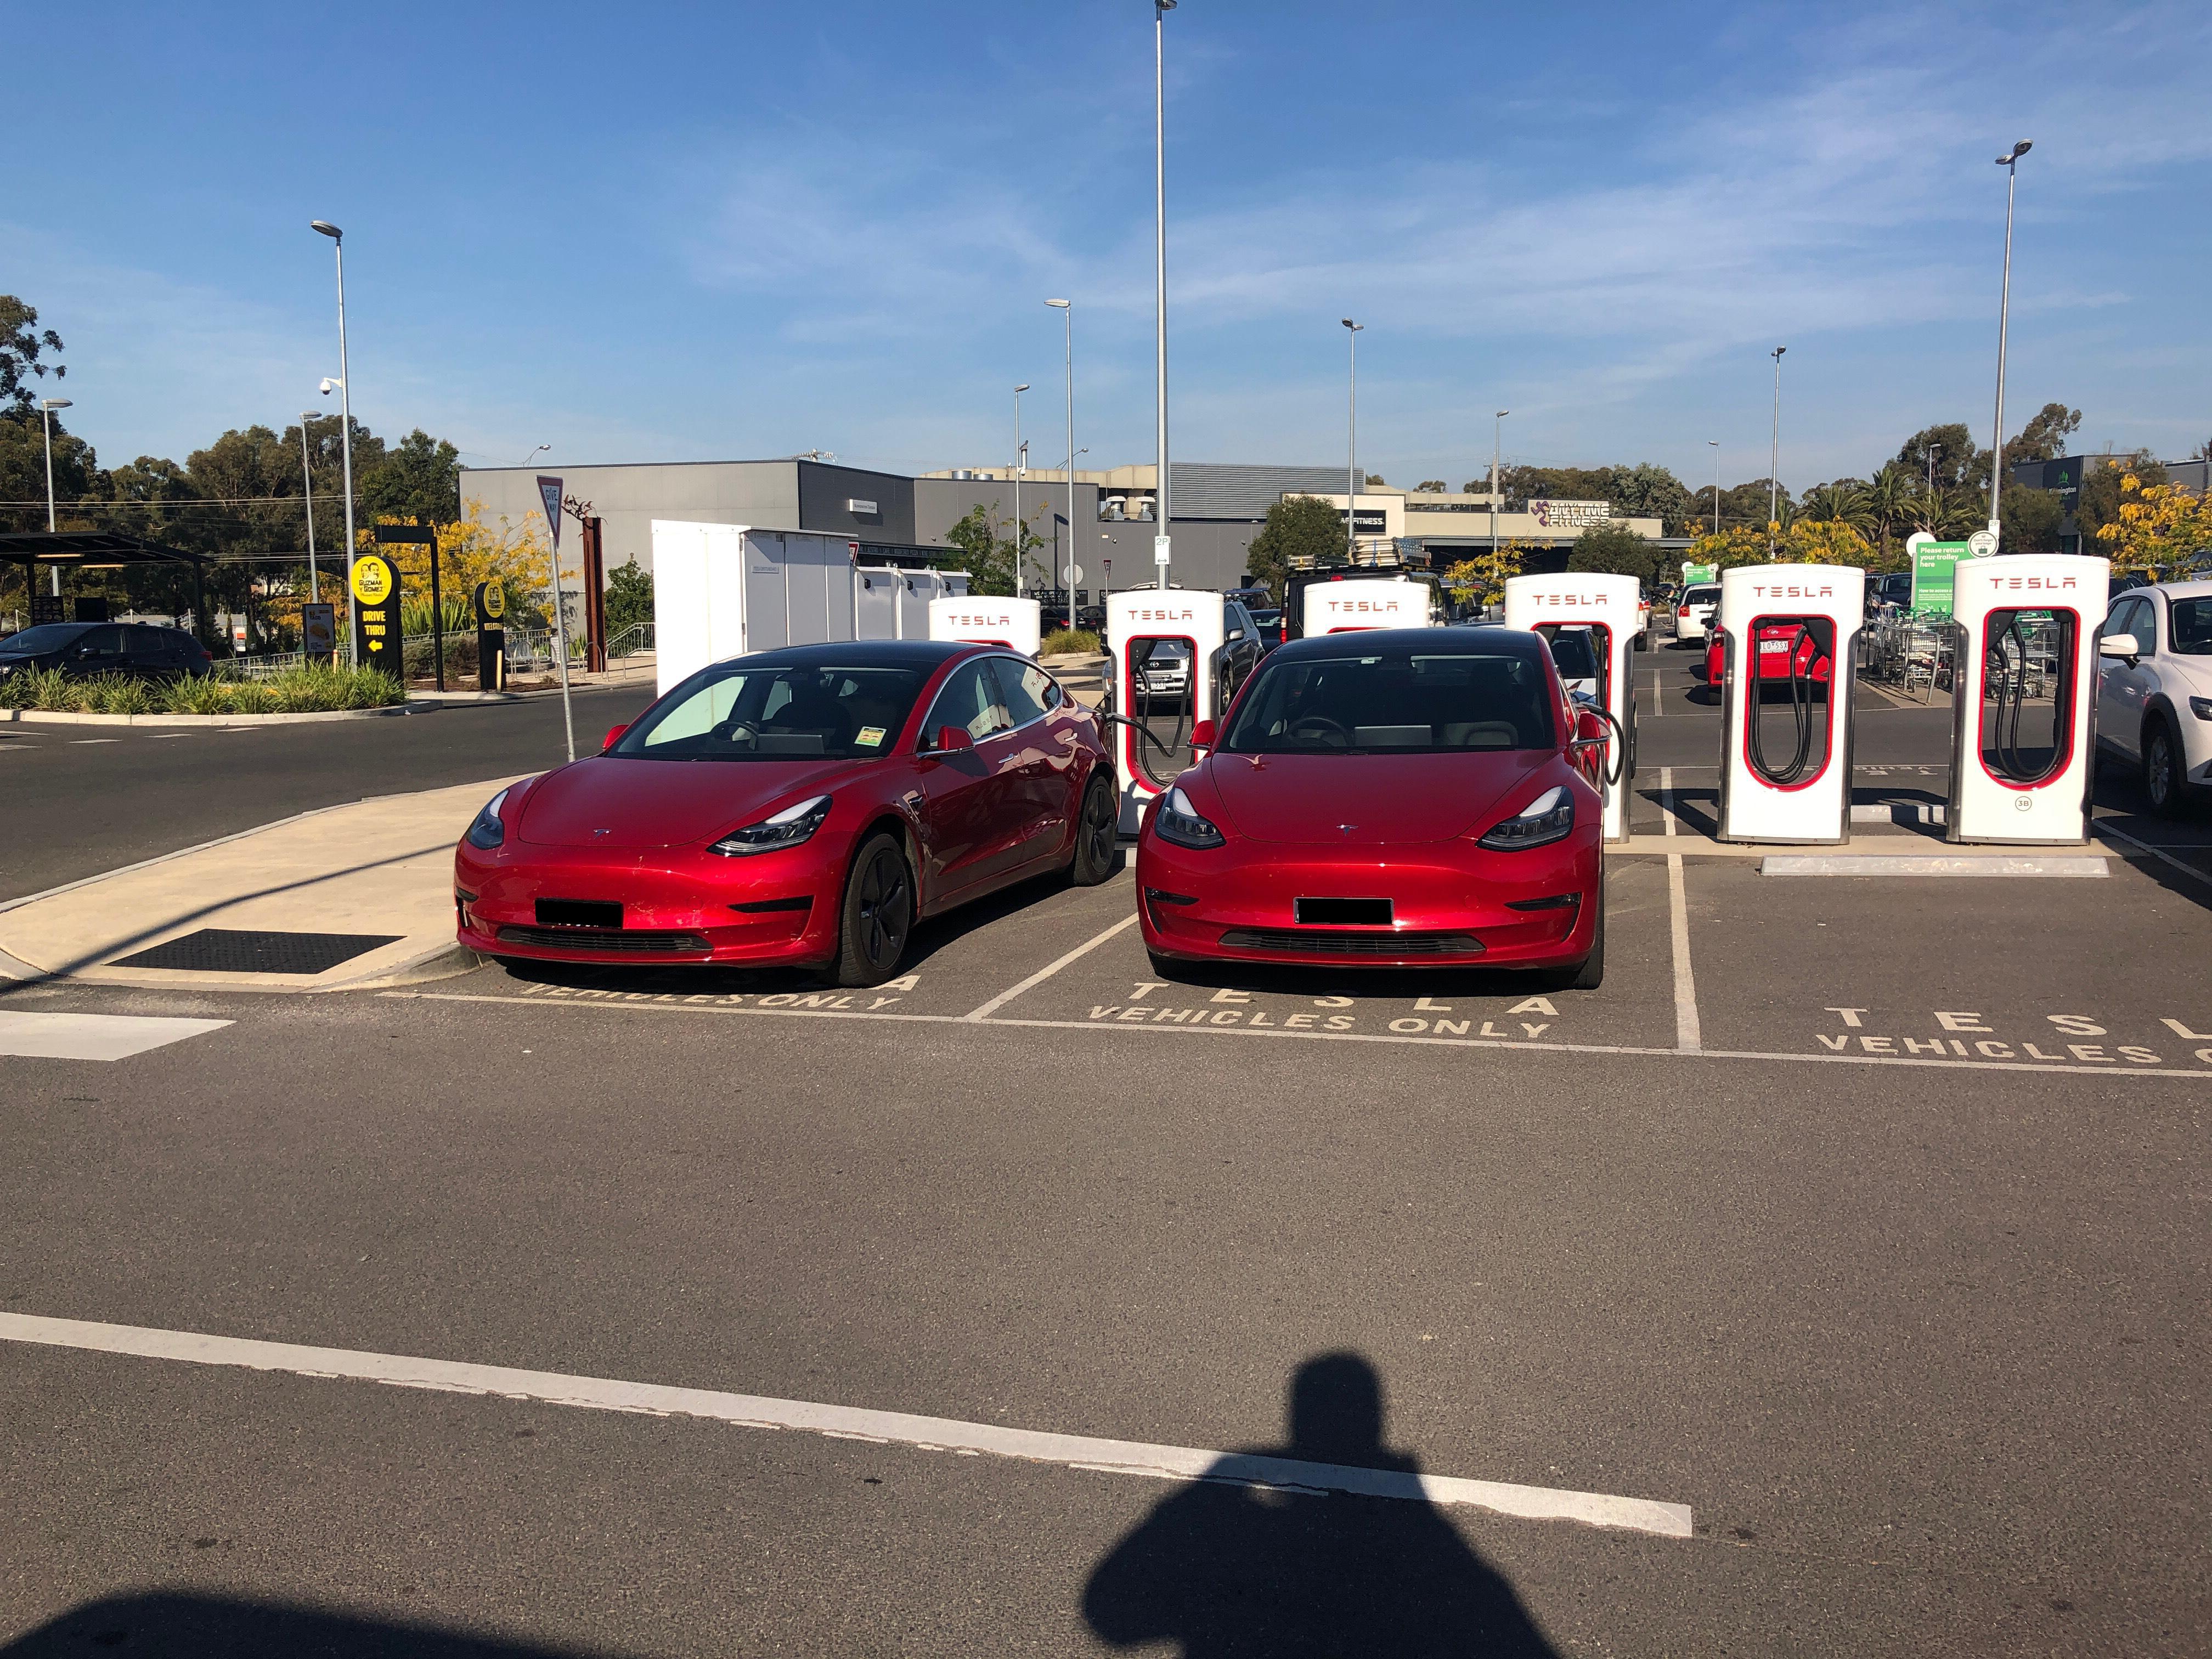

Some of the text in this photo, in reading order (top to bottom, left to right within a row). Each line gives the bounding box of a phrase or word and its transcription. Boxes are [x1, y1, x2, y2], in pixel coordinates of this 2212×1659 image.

[545, 488, 558, 501] GIVE
[1548, 502, 1610, 516] ANYTIME
[1549, 515, 1609, 527] FITNESS
[1990, 577, 2076, 589] TESLA
[1753, 586, 1832, 597] TESLA
[1532, 594, 1607, 606] TESLA
[1328, 601, 1398, 612] TESLA
[363, 611, 386, 622] DRIVE
[948, 616, 1009, 625] TESLA
[1127, 610, 1192, 620] TESLA
[364, 625, 386, 636] THRU
[758, 994, 902, 1010] ONLY
[1128, 983, 1560, 1016] TESLA
[1089, 1005, 1551, 1039] VEHICLES ONLY
[1815, 1035, 2162, 1063] VEHICLES
